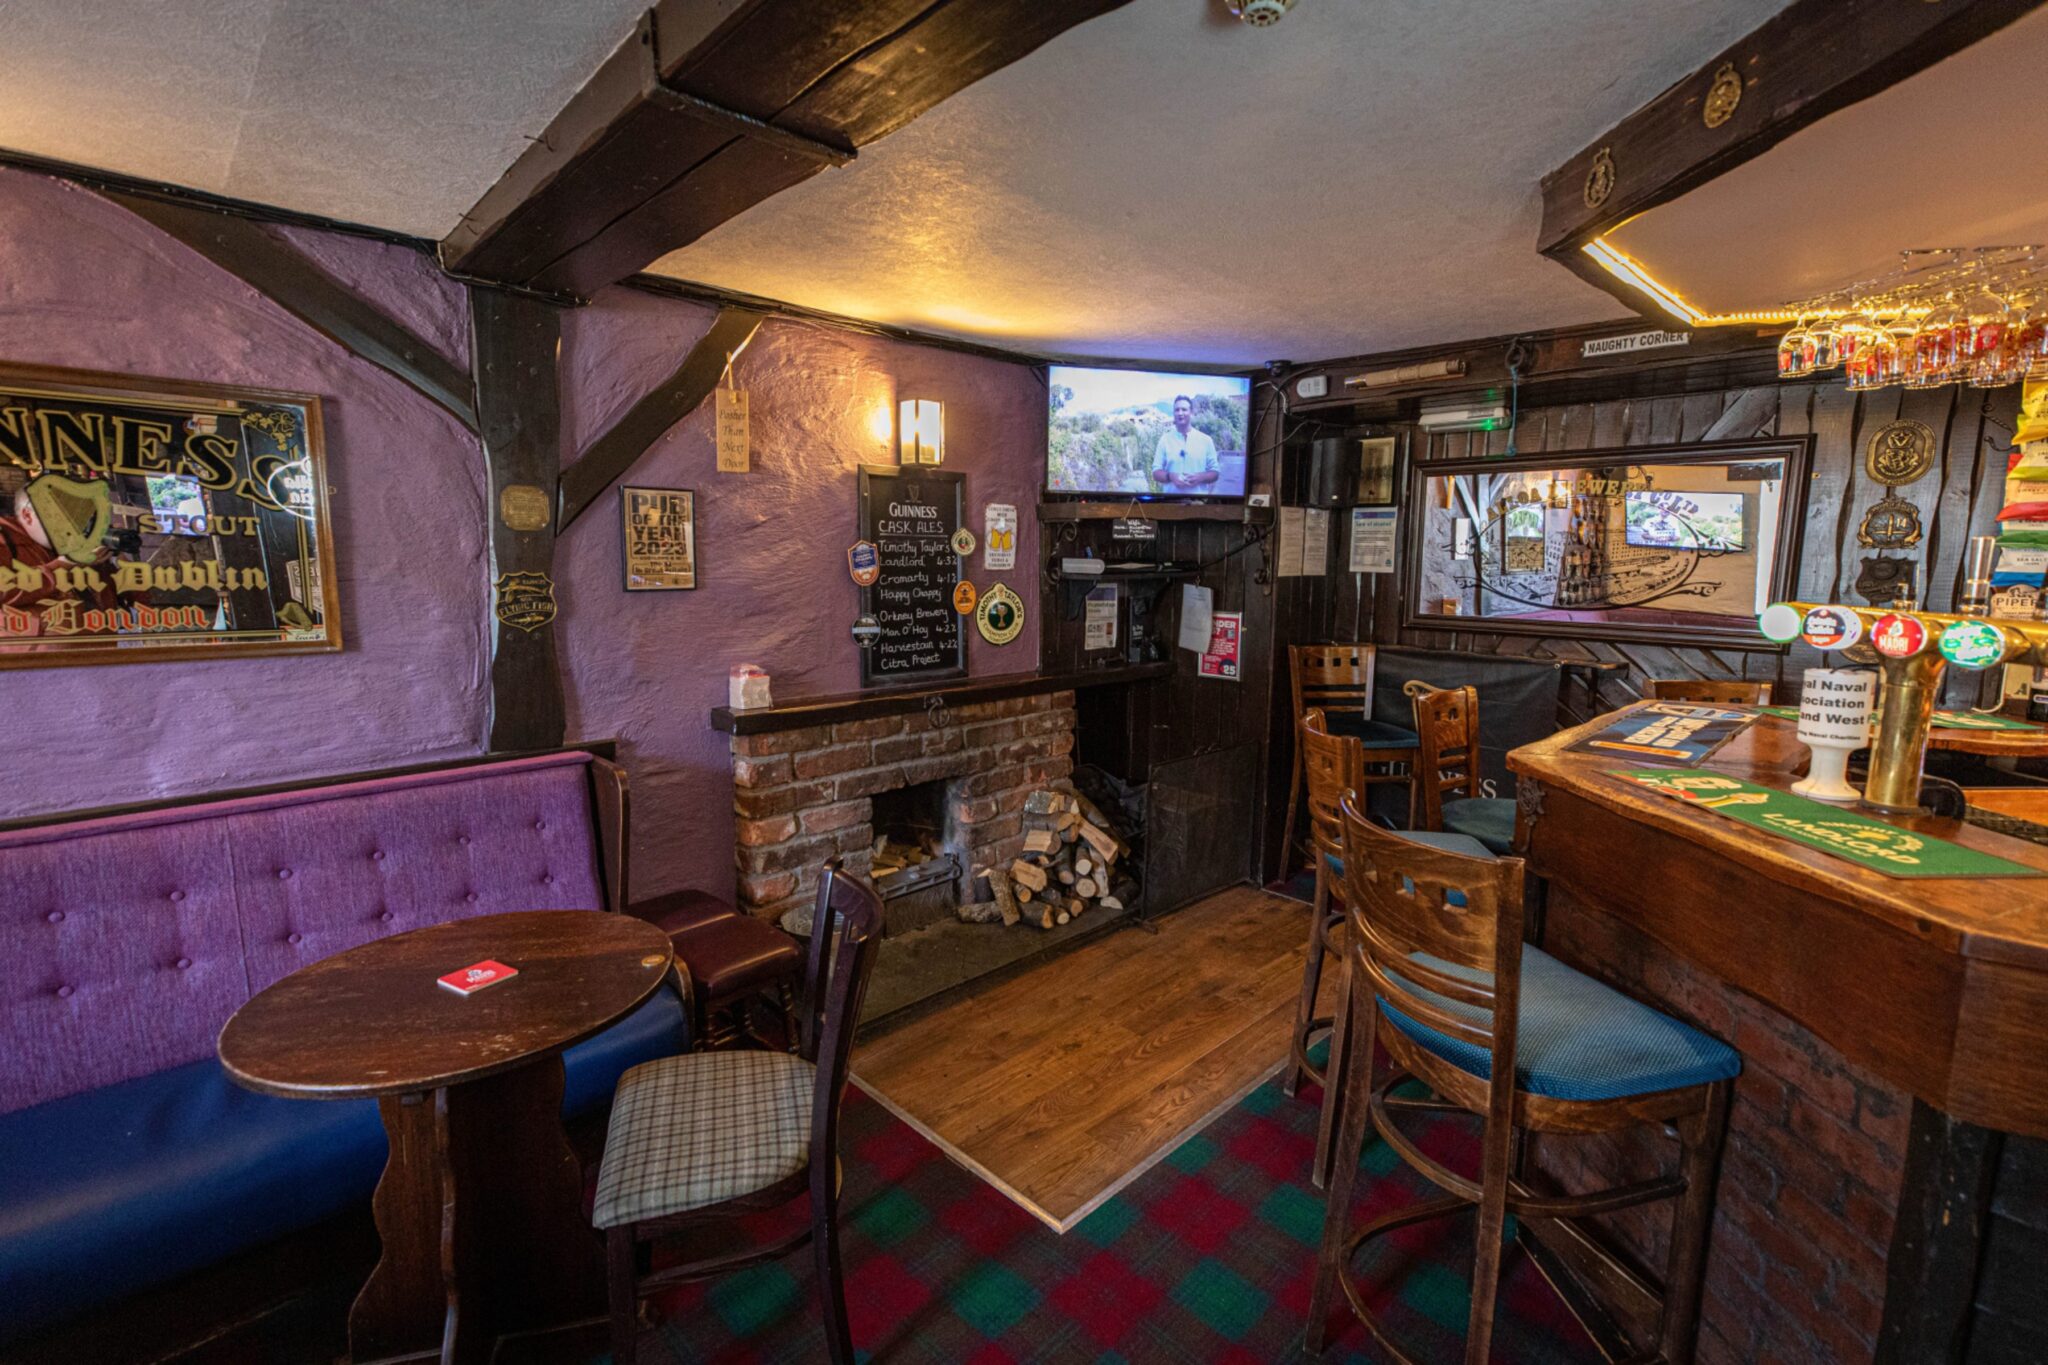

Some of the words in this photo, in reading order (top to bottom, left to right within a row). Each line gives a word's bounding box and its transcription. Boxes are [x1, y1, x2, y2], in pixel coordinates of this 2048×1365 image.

[1587, 337, 1636, 354] NAUGHTY
[1639, 332, 1684, 346] CORNER
[631, 494, 687, 514] PUB
[889, 502, 938, 519] GUINNESS
[138, 513, 261, 536] STOUT
[632, 514, 652, 526] OF
[659, 514, 687, 526] THE
[878, 520, 913, 533] CASK
[916, 520, 944, 533] ALES
[633, 526, 687, 541] YEAR
[633, 541, 688, 555] 2023
[878, 540, 917, 558] Timothy
[919, 539, 951, 556] Taylor's
[880, 555, 926, 567] Landlord
[53, 565, 107, 593] in
[110, 558, 268, 595] Dublin
[879, 571, 929, 586] Cromarty
[499, 602, 530, 618] FLYING
[532, 601, 555, 613] FISH
[979, 591, 997, 620] TIMOTHY
[1004, 590, 1023, 619] TAYLOR'S
[36, 598, 210, 635] London
[880, 610, 914, 626] Orkney
[916, 607, 949, 624] Brewery
[881, 627, 901, 637] Man
[912, 624, 929, 639] Hoy
[881, 657, 910, 670] Citra
[912, 652, 941, 667] Project
[1223, 664, 1236, 675] 25
[1804, 679, 1817, 689] al
[1821, 680, 1868, 692] Naval
[1826, 713, 1865, 725] West
[1761, 813, 1921, 865] LANDLORD
